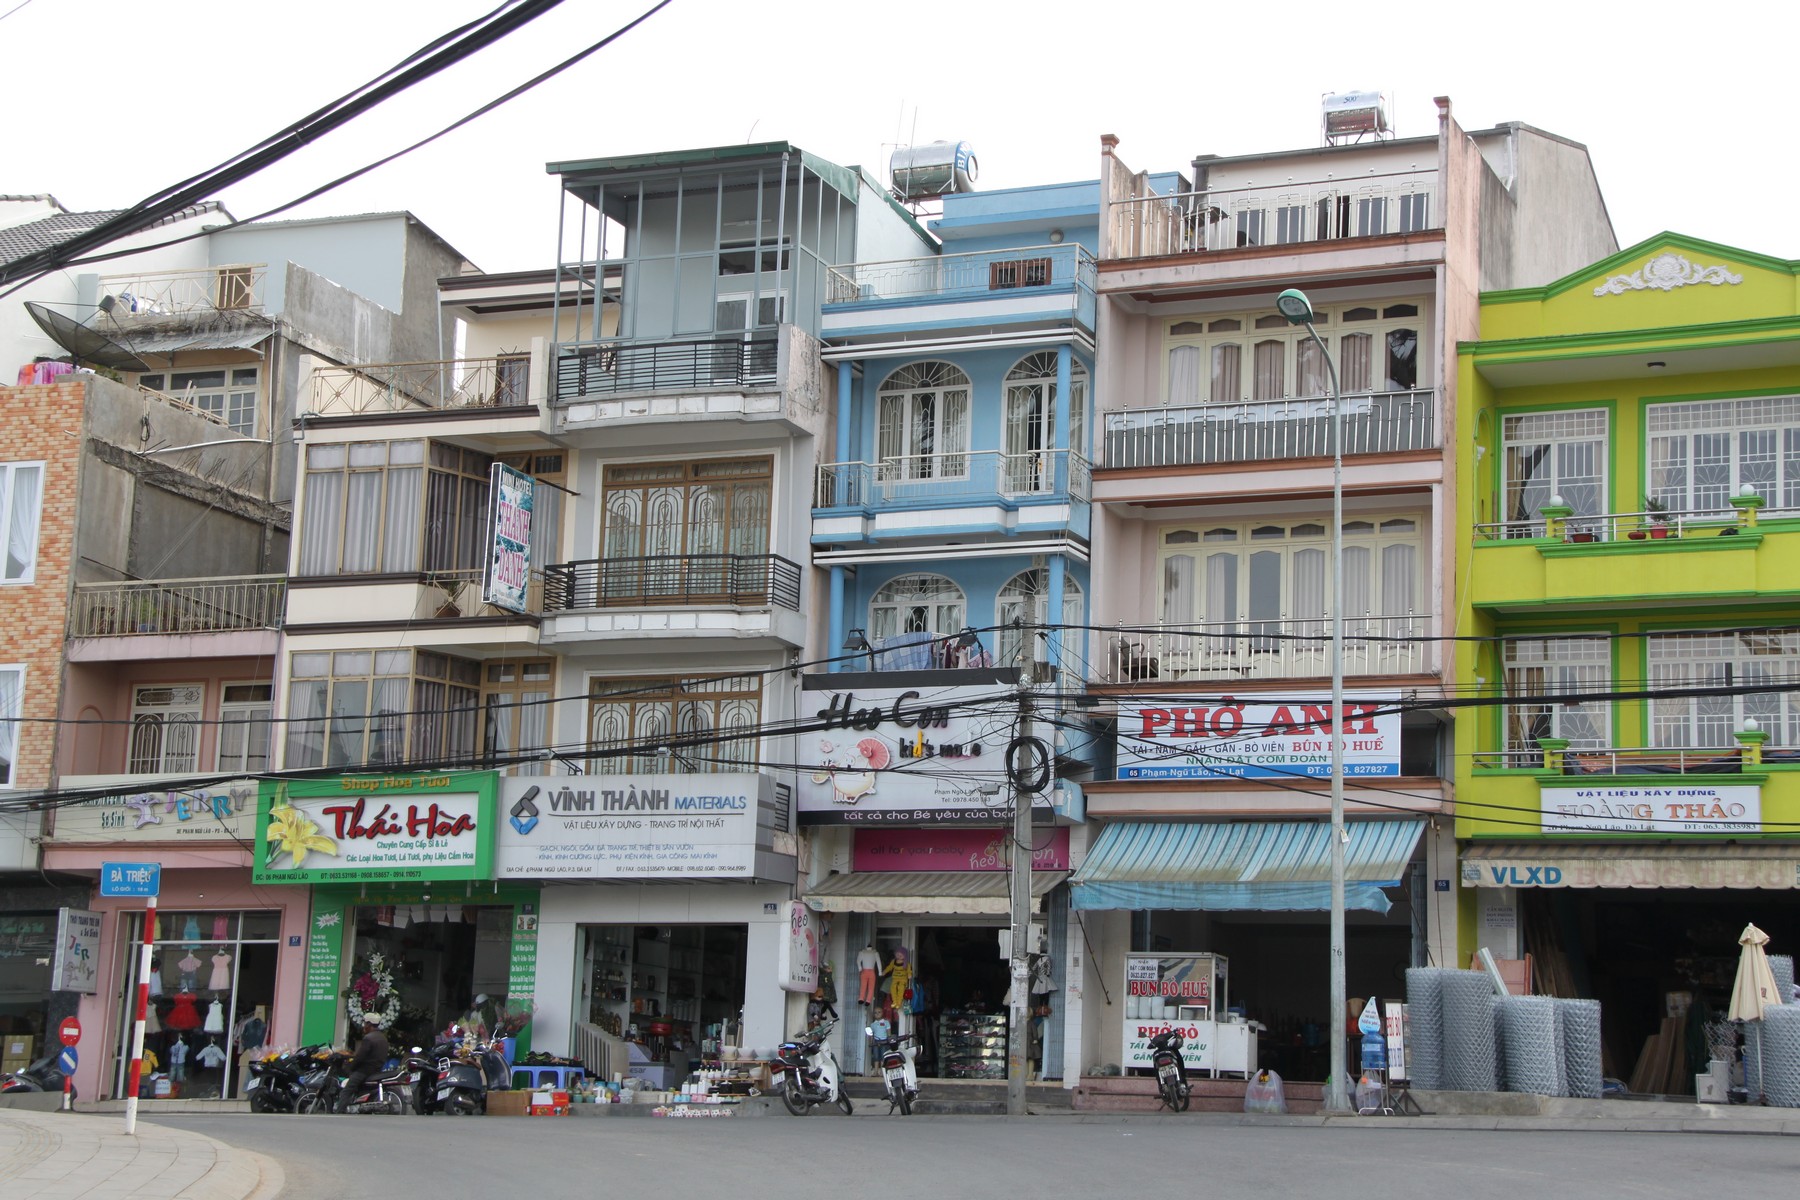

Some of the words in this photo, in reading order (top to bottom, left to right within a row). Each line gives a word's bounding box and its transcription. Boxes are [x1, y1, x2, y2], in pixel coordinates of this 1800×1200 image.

[515, 477, 532, 496] HOTEL
[817, 692, 882, 731] Heo
[1261, 704, 1379, 736] ANH
[899, 730, 934, 758] kid's
[1292, 739, 1322, 752] BÚN
[1352, 736, 1384, 751] HUẾ
[1129, 769, 1139, 777] 65
[1354, 765, 1388, 773] 827827
[342, 777, 379, 791] Shop
[384, 776, 413, 788] Hoa
[548, 786, 595, 812] VĨNH
[601, 784, 670, 811] THÀNH
[674, 796, 747, 810] MATERIALS
[1608, 789, 1639, 799] LIỆU
[1678, 789, 1717, 798] DỰNG
[165, 787, 251, 821] JERRY
[1556, 798, 1654, 820] HOÀNG
[1664, 797, 1746, 819] THẢO
[322, 797, 402, 839] Thái
[406, 803, 476, 840] Hòa
[563, 820, 579, 830] VẬT
[580, 819, 597, 830] LIỆU
[598, 819, 616, 829] XÂY
[618, 819, 642, 829] DỰNG
[649, 819, 676, 829] TRANG
[678, 818, 689, 828] TRÍ
[689, 818, 704, 829] NỘI
[705, 817, 724, 828] THẤT
[844, 811, 863, 820] tất
[867, 810, 882, 820] cả
[887, 810, 909, 820] cho
[914, 810, 931, 819] Bé
[936, 810, 960, 820] yêu
[965, 810, 988, 819] của
[399, 840, 414, 850] Cung
[462, 851, 474, 860] Hoa
[969, 852, 996, 870] heo
[111, 867, 123, 882] BÀ
[126, 867, 151, 885] TRIỆU
[1491, 866, 1562, 885] VLXD
[1161, 977, 1179, 996] BÒ
[1181, 975, 1208, 996] HUẾ
